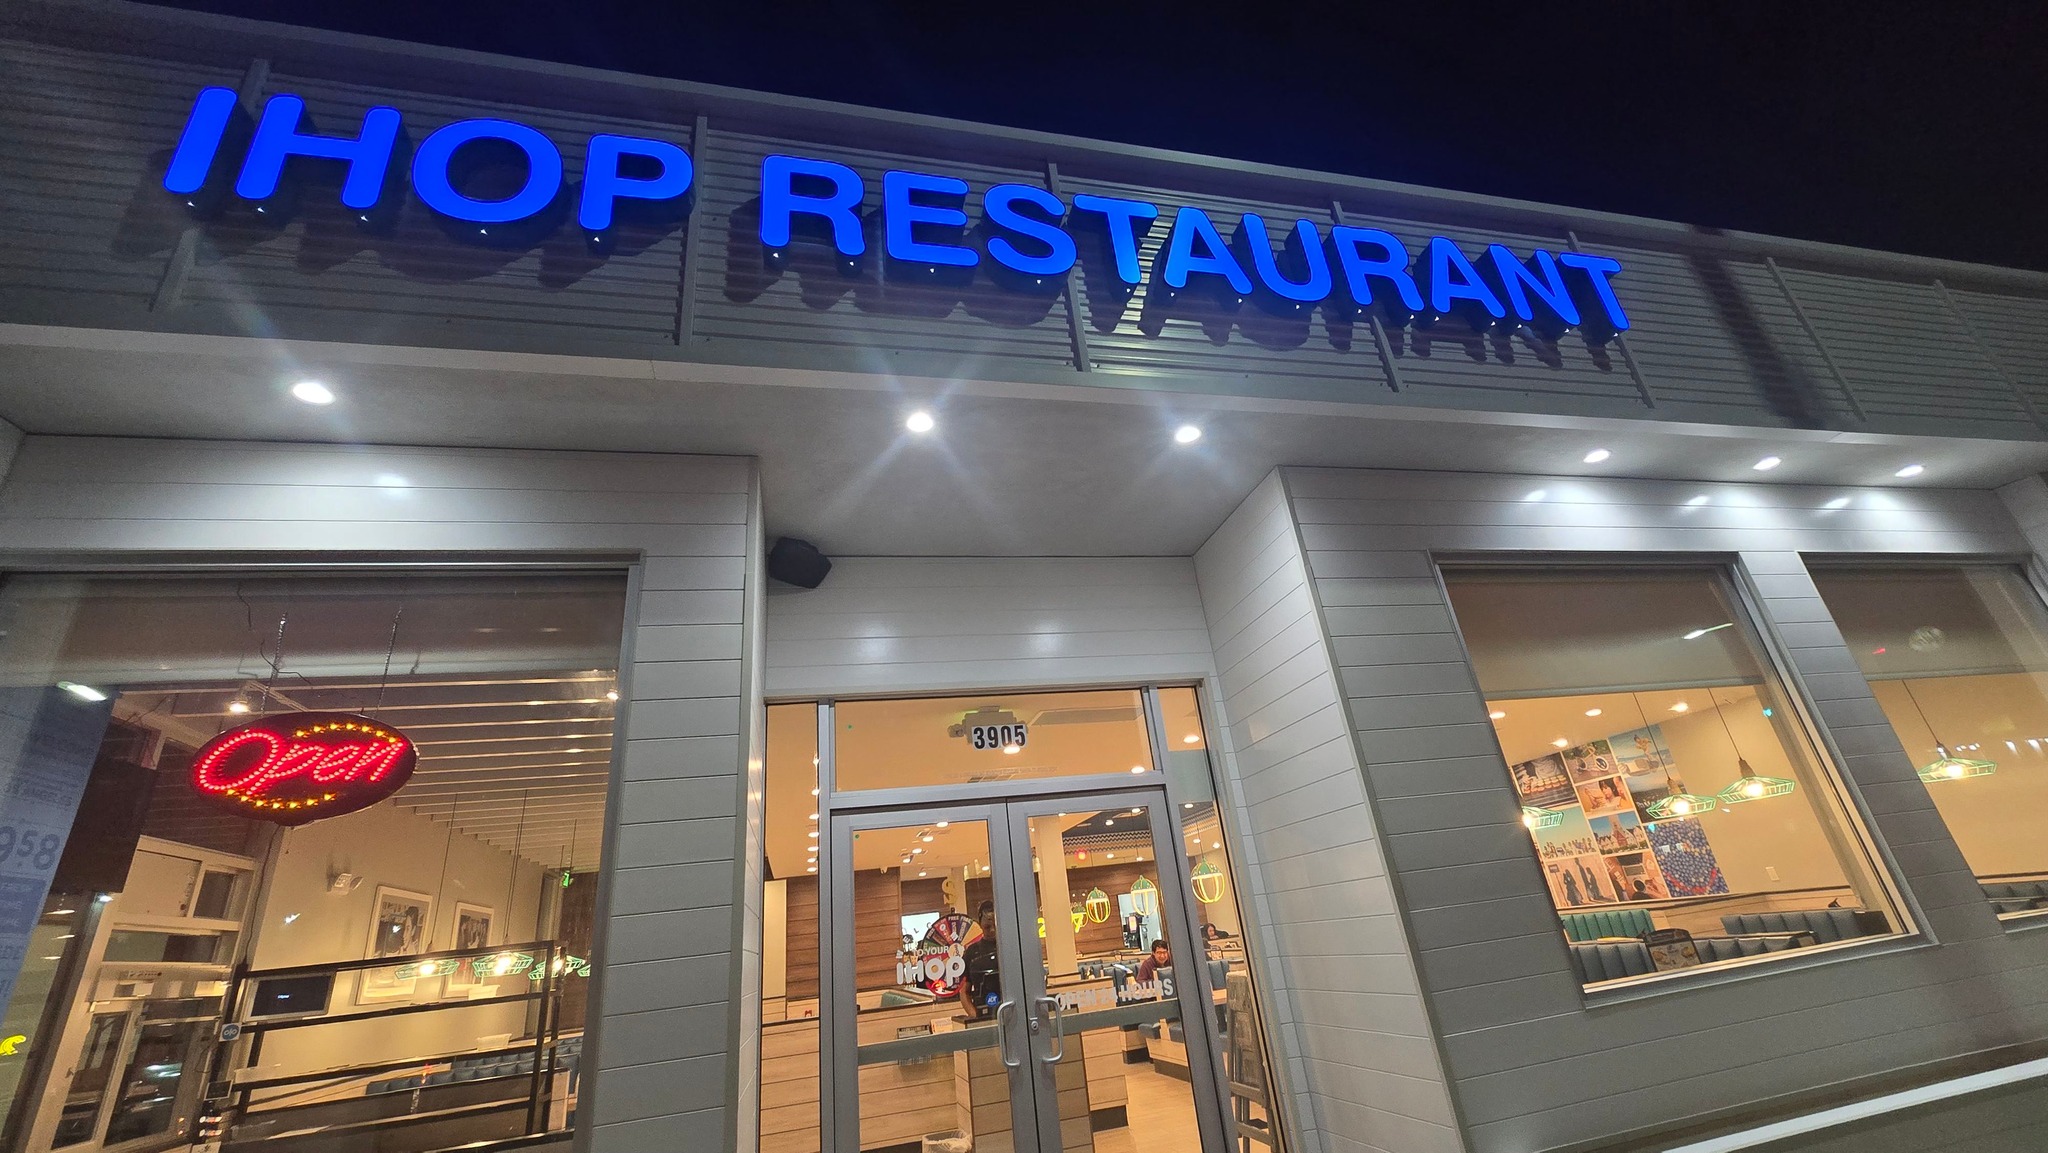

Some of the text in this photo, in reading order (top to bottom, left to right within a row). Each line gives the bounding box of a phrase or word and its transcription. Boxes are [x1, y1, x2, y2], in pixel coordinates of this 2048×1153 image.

[164, 86, 1631, 331] IHOP RESTAURANT
[973, 724, 1026, 750] 3905
[196, 730, 407, 797] Open
[925, 945, 950, 955] YOUR
[1119, 978, 1174, 1001] HOURS
